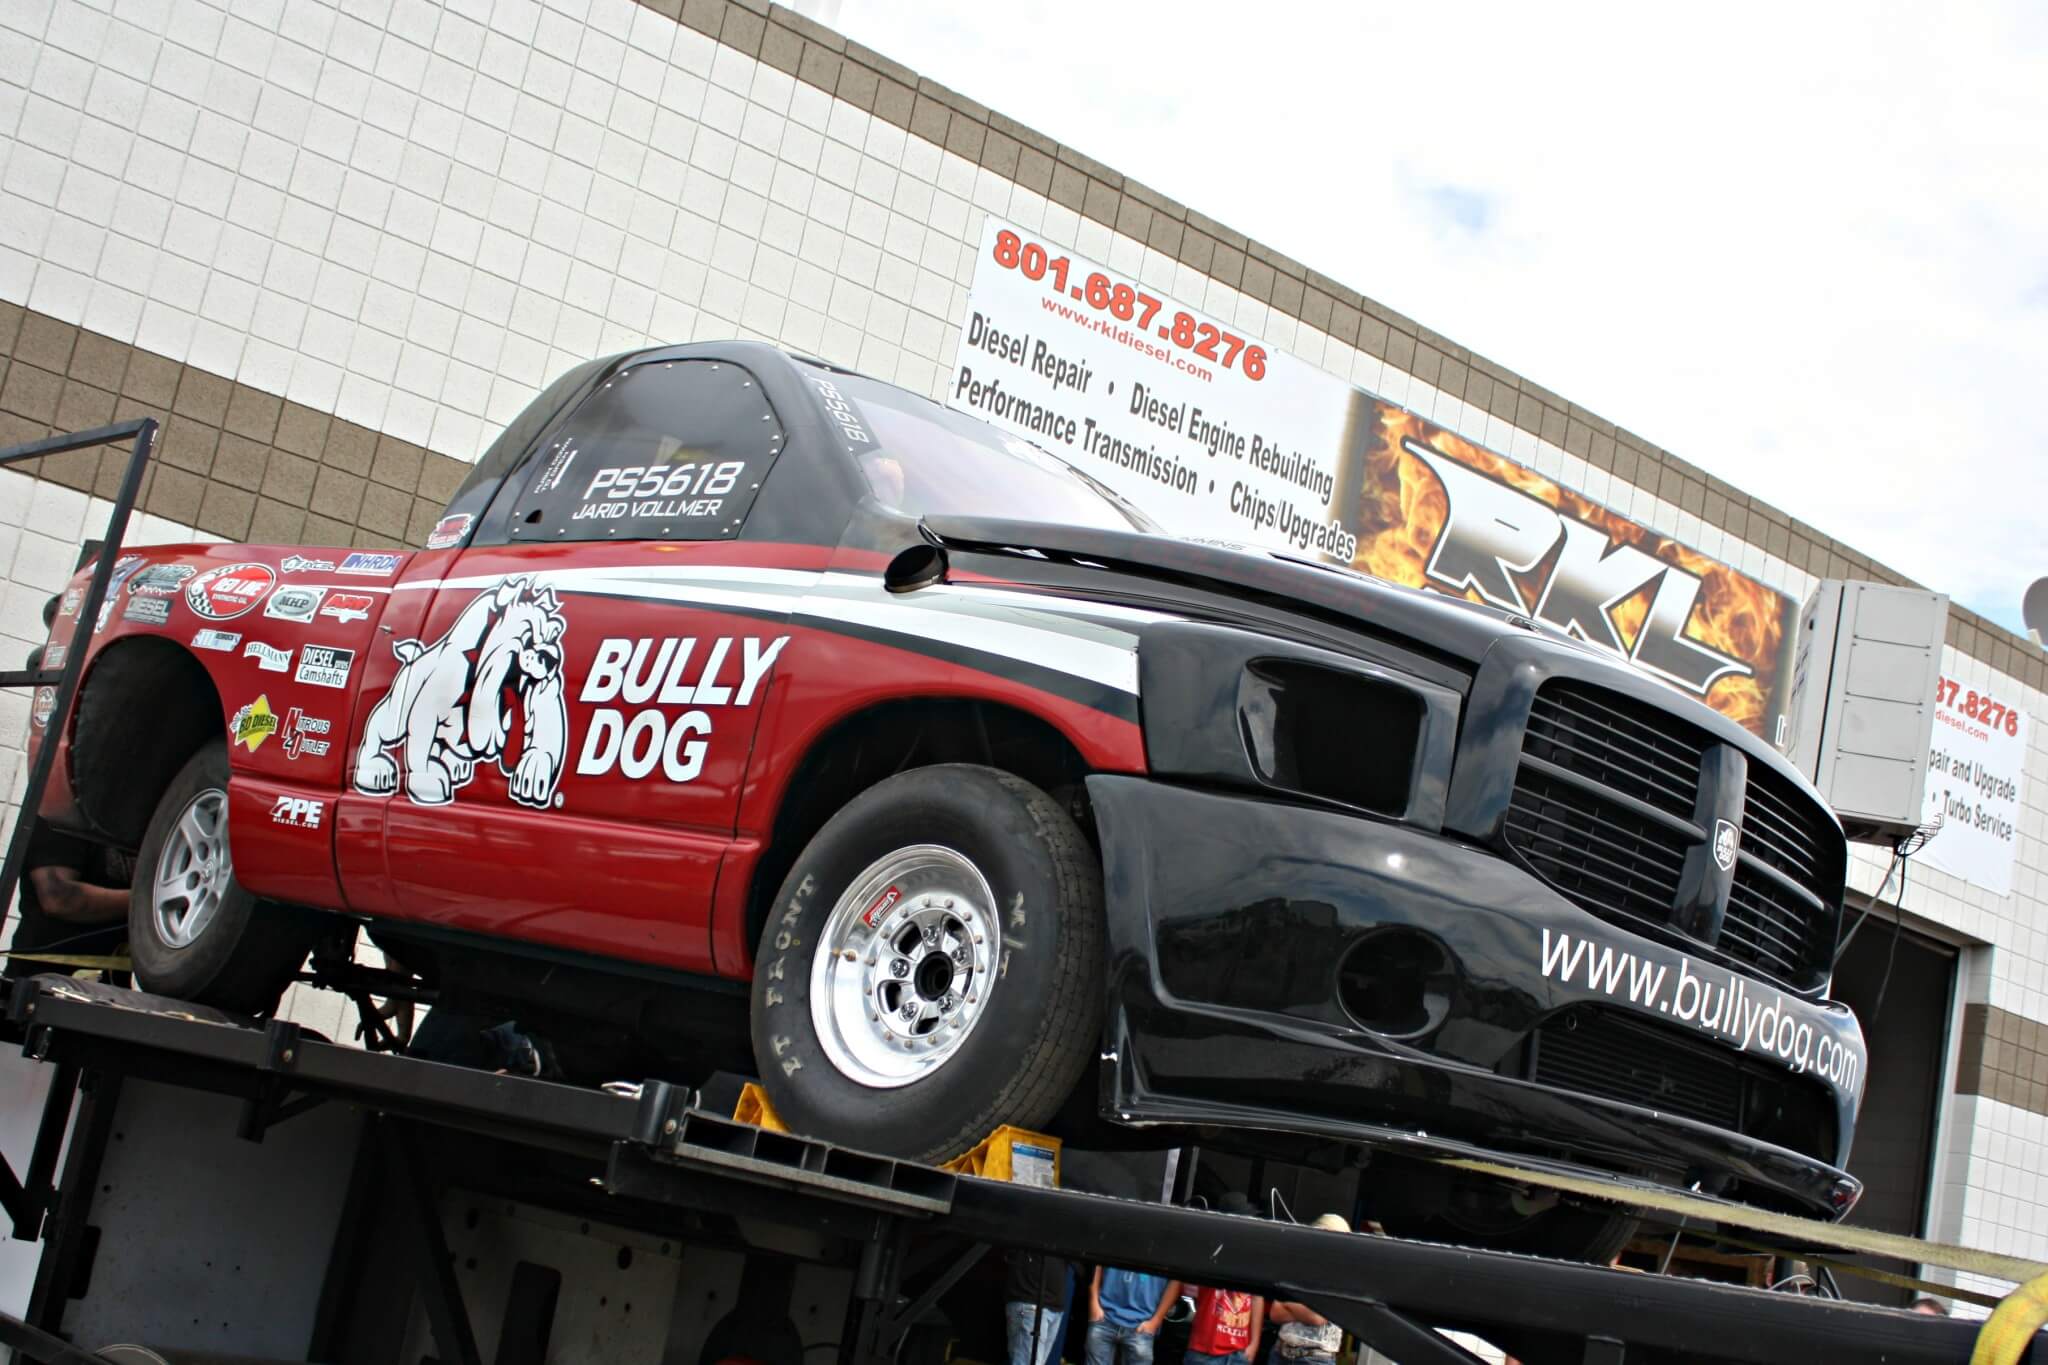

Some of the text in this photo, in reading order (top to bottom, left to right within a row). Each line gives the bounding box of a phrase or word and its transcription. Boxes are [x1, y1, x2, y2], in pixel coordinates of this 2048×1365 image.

[992, 229, 1268, 382] 801.687.8276
[1041, 295, 1213, 383] www.rkldiesel.com
[808, 376, 870, 443] PS5618
[968, 311, 1335, 505] Diesel Repair Diesel Engine Rebuilding
[583, 461, 745, 500] PS5618
[955, 366, 1357, 561] Performance Transmission Chips/Upgrades
[572, 499, 723, 520] JARID VOLLMER
[1401, 435, 1753, 695] RKL
[248, 642, 289, 664] HELLMANN
[299, 666, 344, 685] Camshafts
[303, 648, 334, 668] DIESEL
[579, 635, 792, 706] BULLY
[251, 713, 277, 730] DIESEL
[575, 707, 713, 782] DOG
[268, 795, 324, 824] PPE
[1951, 760, 1971, 786] and
[1974, 759, 2016, 804] Upgrade
[1943, 789, 2013, 842] Turbo Service
[1540, 927, 1858, 1093] www.bullydog.com
